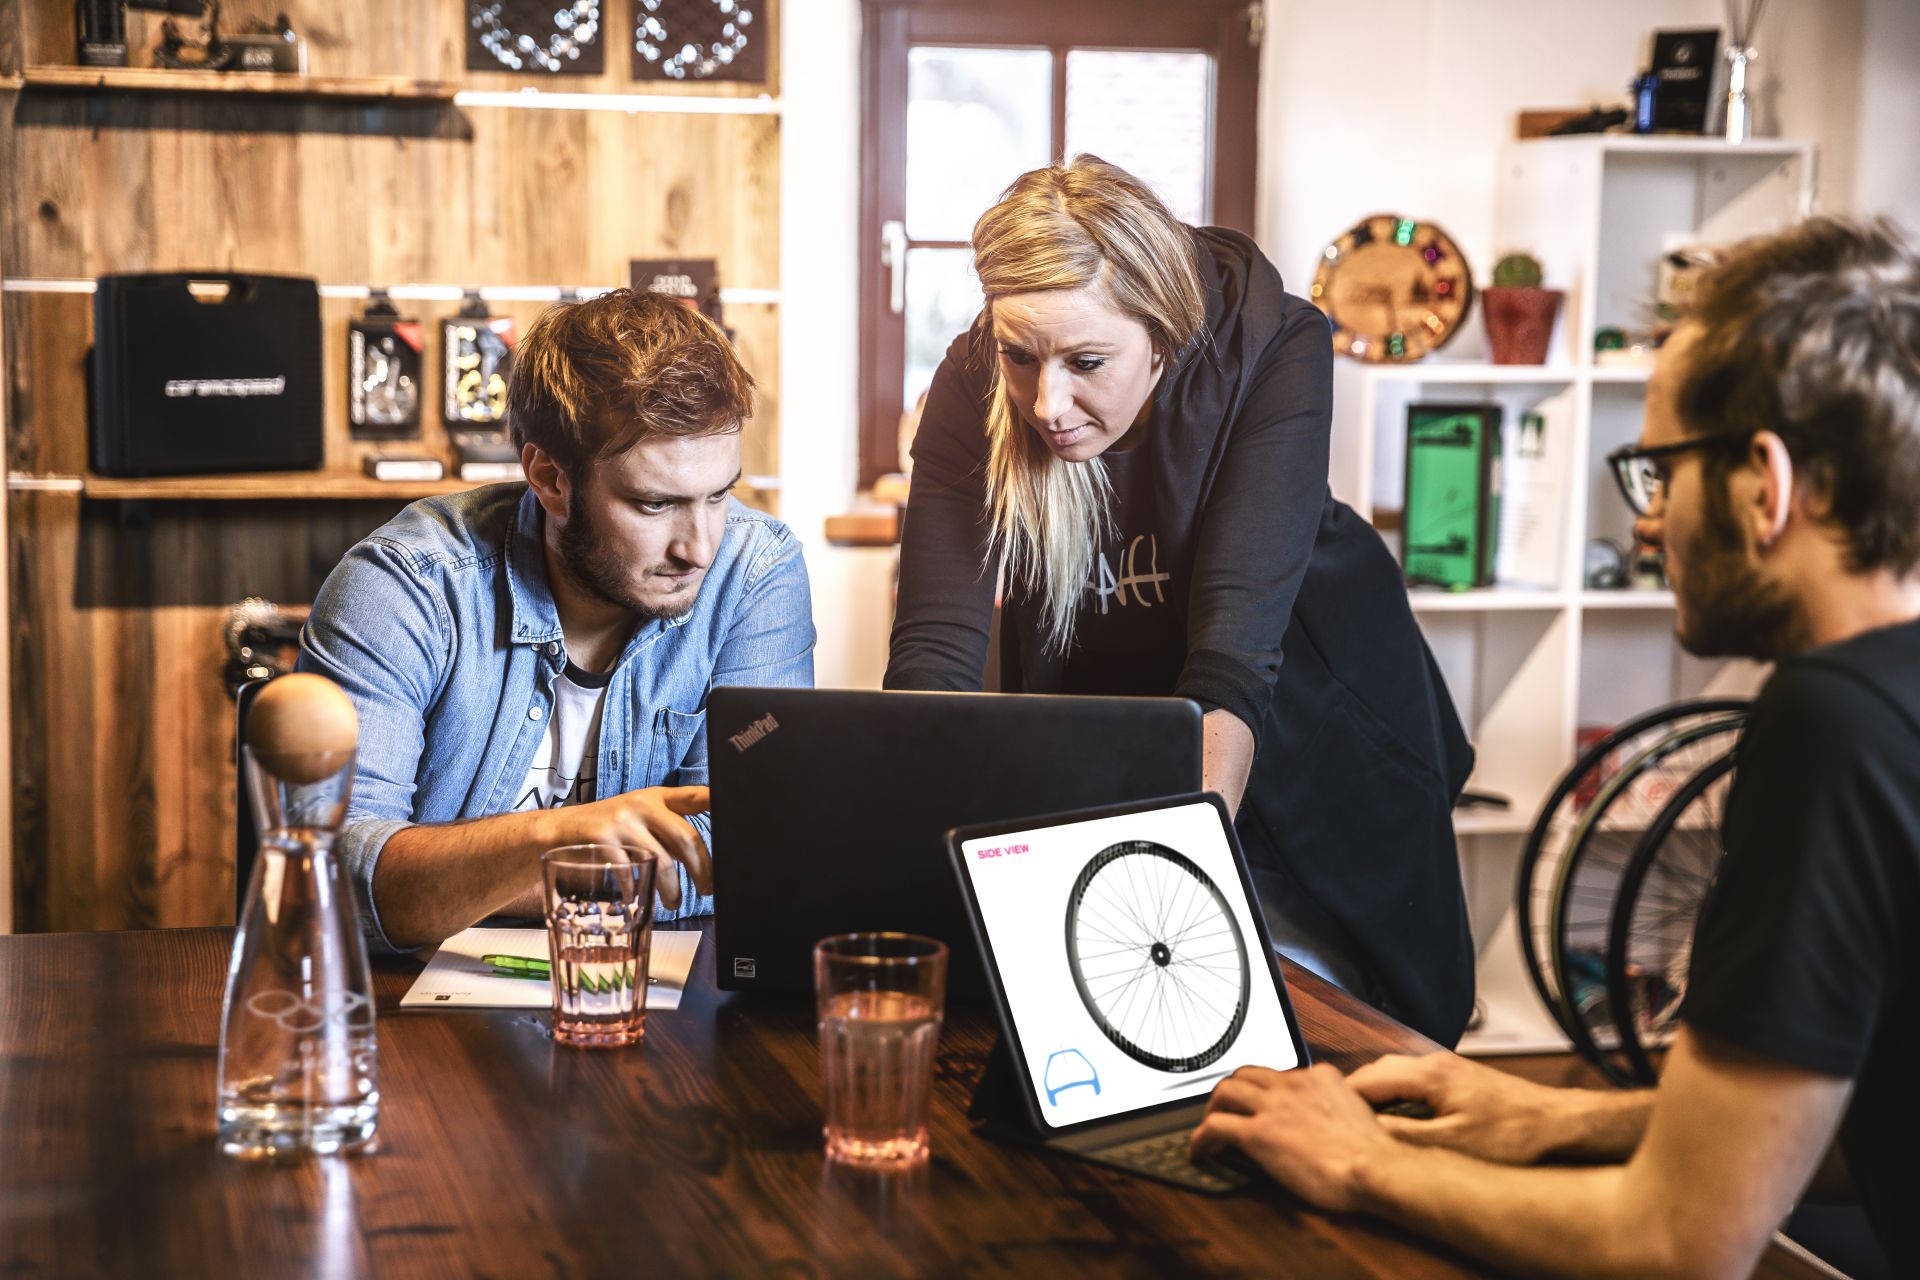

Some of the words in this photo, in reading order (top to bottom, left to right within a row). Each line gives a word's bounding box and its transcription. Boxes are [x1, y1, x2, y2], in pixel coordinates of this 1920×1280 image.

[728, 712, 780, 752] ThinkPad
[977, 847, 1003, 859] SIDE
[1003, 844, 1029, 855] VIEW
